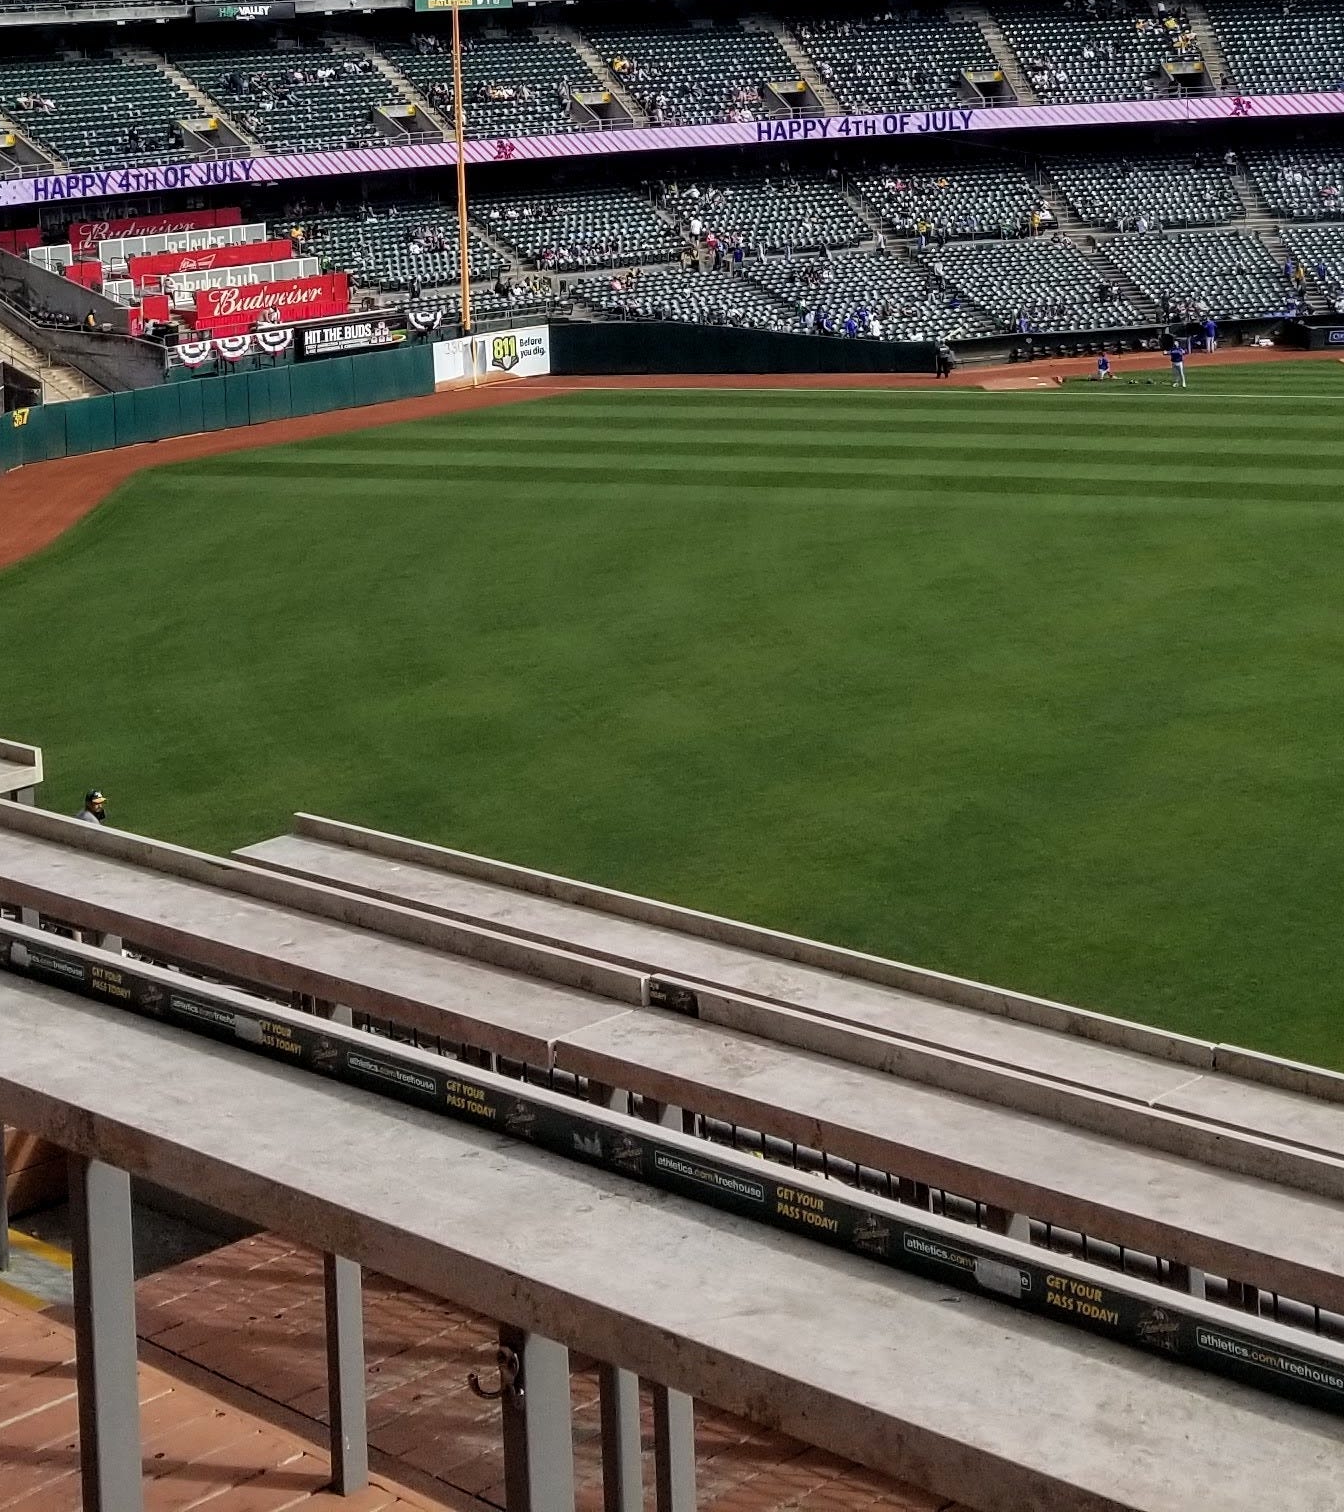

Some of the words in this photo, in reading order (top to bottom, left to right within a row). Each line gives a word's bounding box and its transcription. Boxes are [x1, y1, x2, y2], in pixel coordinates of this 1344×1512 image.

[757, 117, 830, 141] HAPPY
[884, 114, 911, 134] OF
[918, 110, 973, 132] JULY
[34, 172, 111, 200] HAPPY
[163, 165, 191, 188] OF
[199, 159, 254, 185] JULY
[208, 285, 322, 316] Budweiser
[304, 330, 321, 345] HIT
[323, 327, 343, 343] THE
[493, 336, 516, 359] 811
[519, 337, 542, 348] Before
[520, 348, 532, 359] you
[446, 1080, 462, 1094] GET
[462, 1085, 485, 1102] YOUR
[446, 1094, 465, 1109] PASS
[466, 1100, 496, 1119] TODAY!
[776, 1187, 795, 1203] GET
[796, 1192, 824, 1211] YOUR
[777, 1202, 801, 1221] PASS
[801, 1210, 838, 1233] TODAY!
[1046, 1275, 1068, 1293] GET
[1069, 1279, 1103, 1303] YOUR
[1047, 1292, 1074, 1311] PASS
[1074, 1299, 1119, 1326] TODAY!
